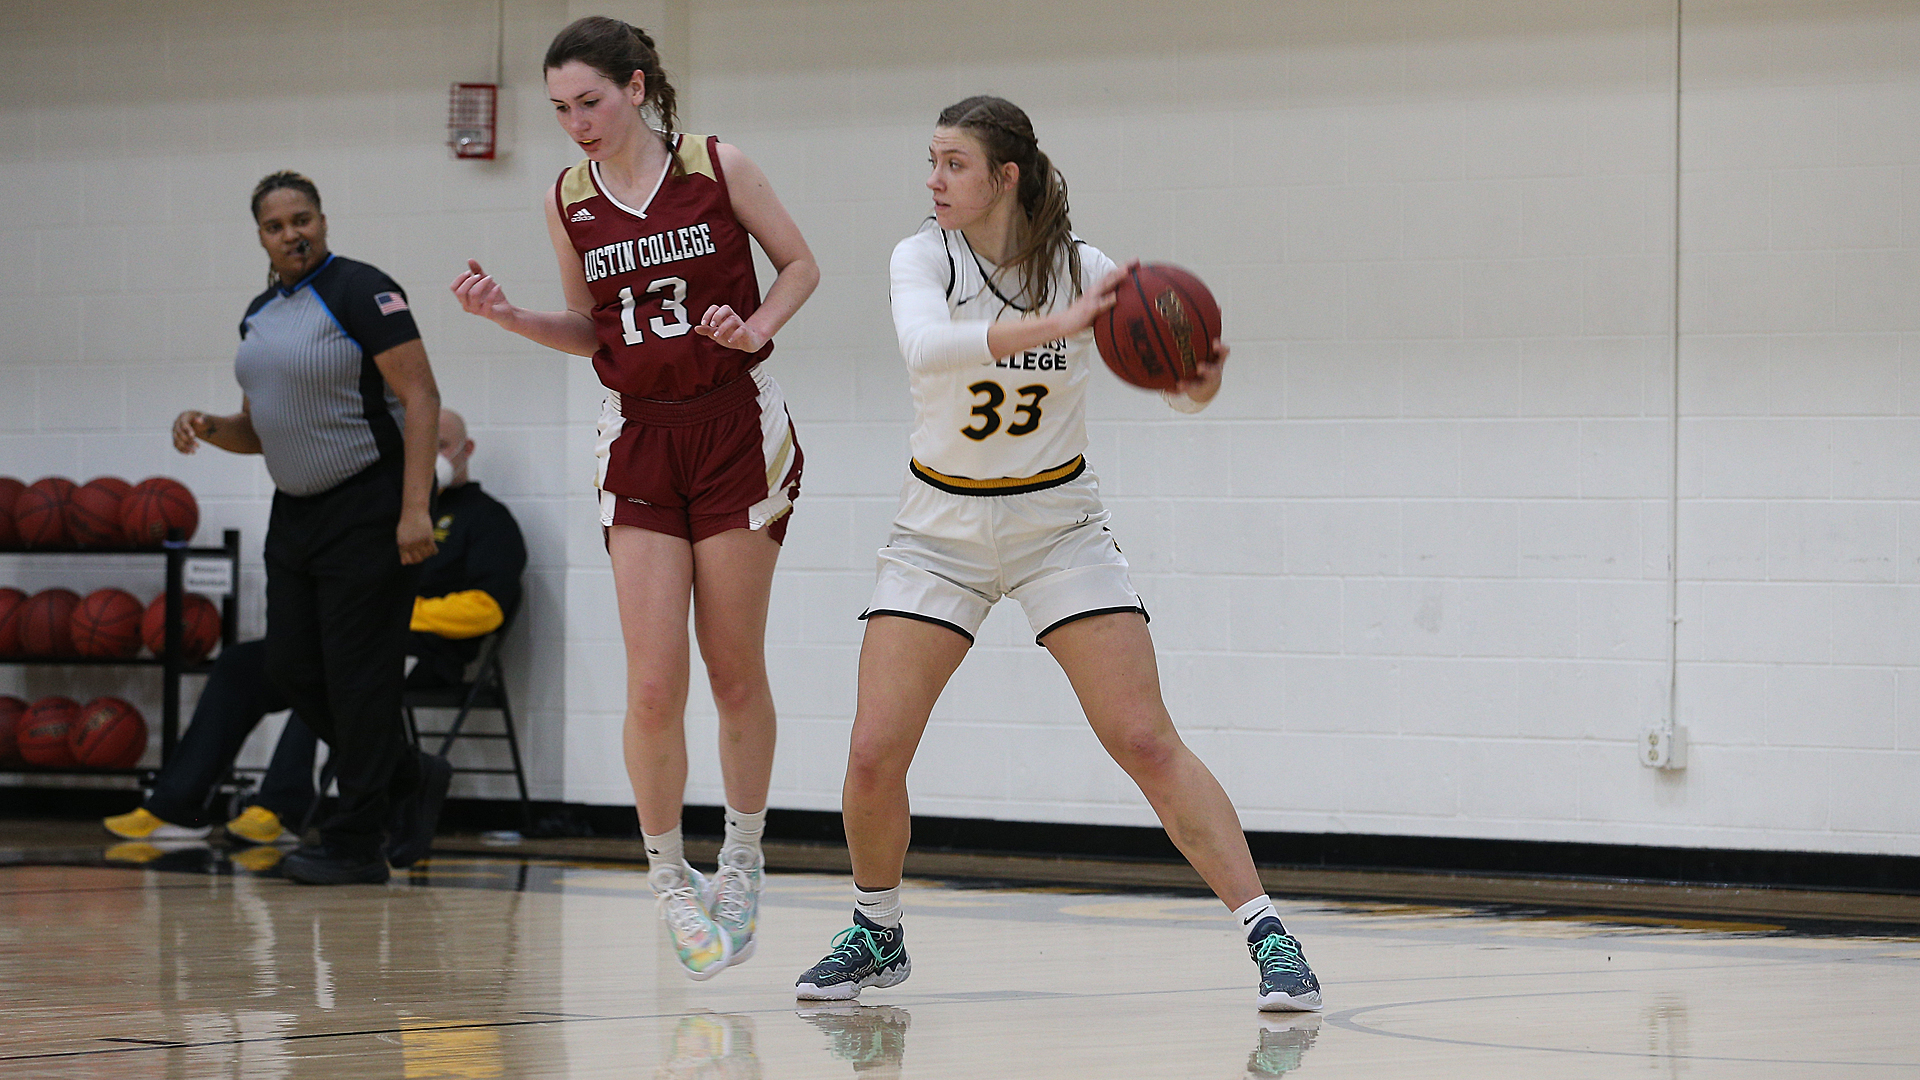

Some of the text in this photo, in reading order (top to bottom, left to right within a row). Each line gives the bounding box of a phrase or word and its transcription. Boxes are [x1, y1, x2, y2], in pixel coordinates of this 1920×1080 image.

[637, 222, 716, 267] COLLEGE
[617, 275, 693, 346] 13
[995, 350, 1067, 371] LLEGE
[959, 379, 1051, 443] 33
